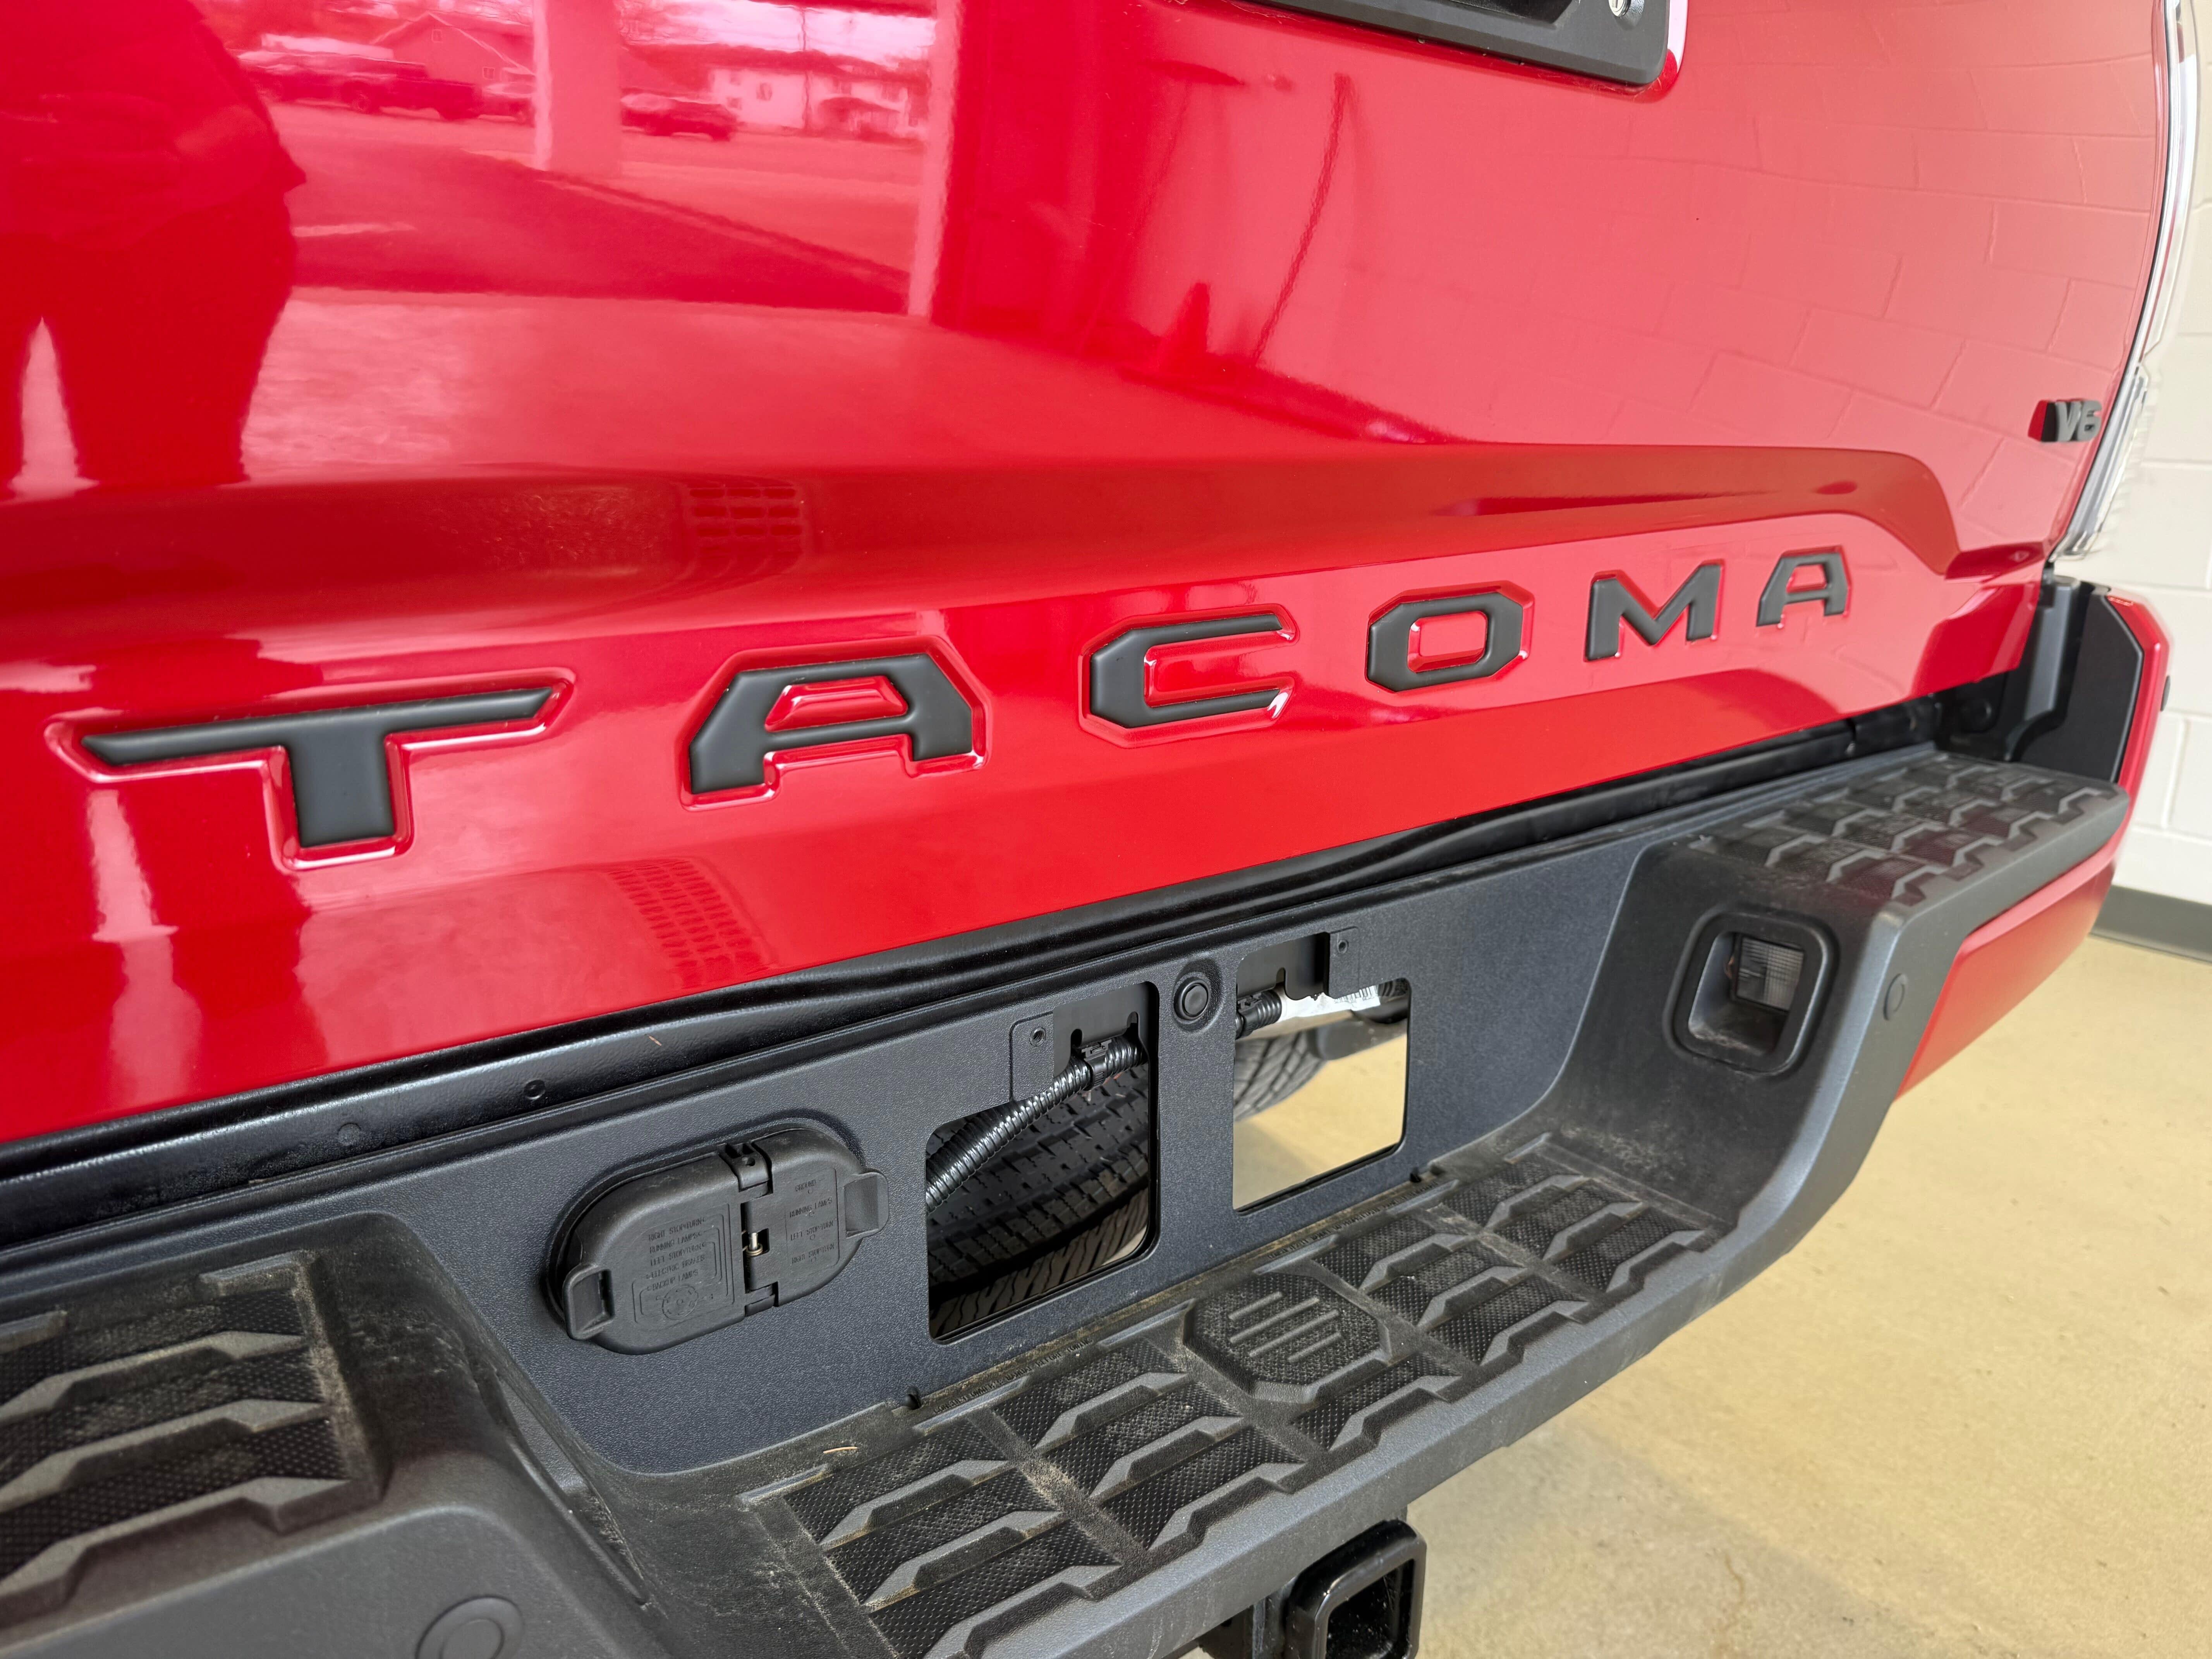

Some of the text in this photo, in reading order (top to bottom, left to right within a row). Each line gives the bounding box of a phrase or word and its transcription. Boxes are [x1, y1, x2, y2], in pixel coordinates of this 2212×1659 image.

[2052, 399, 2102, 442] V6
[79, 548, 1851, 848] TACOMA
[649, 1230, 665, 1242] RIGHT
